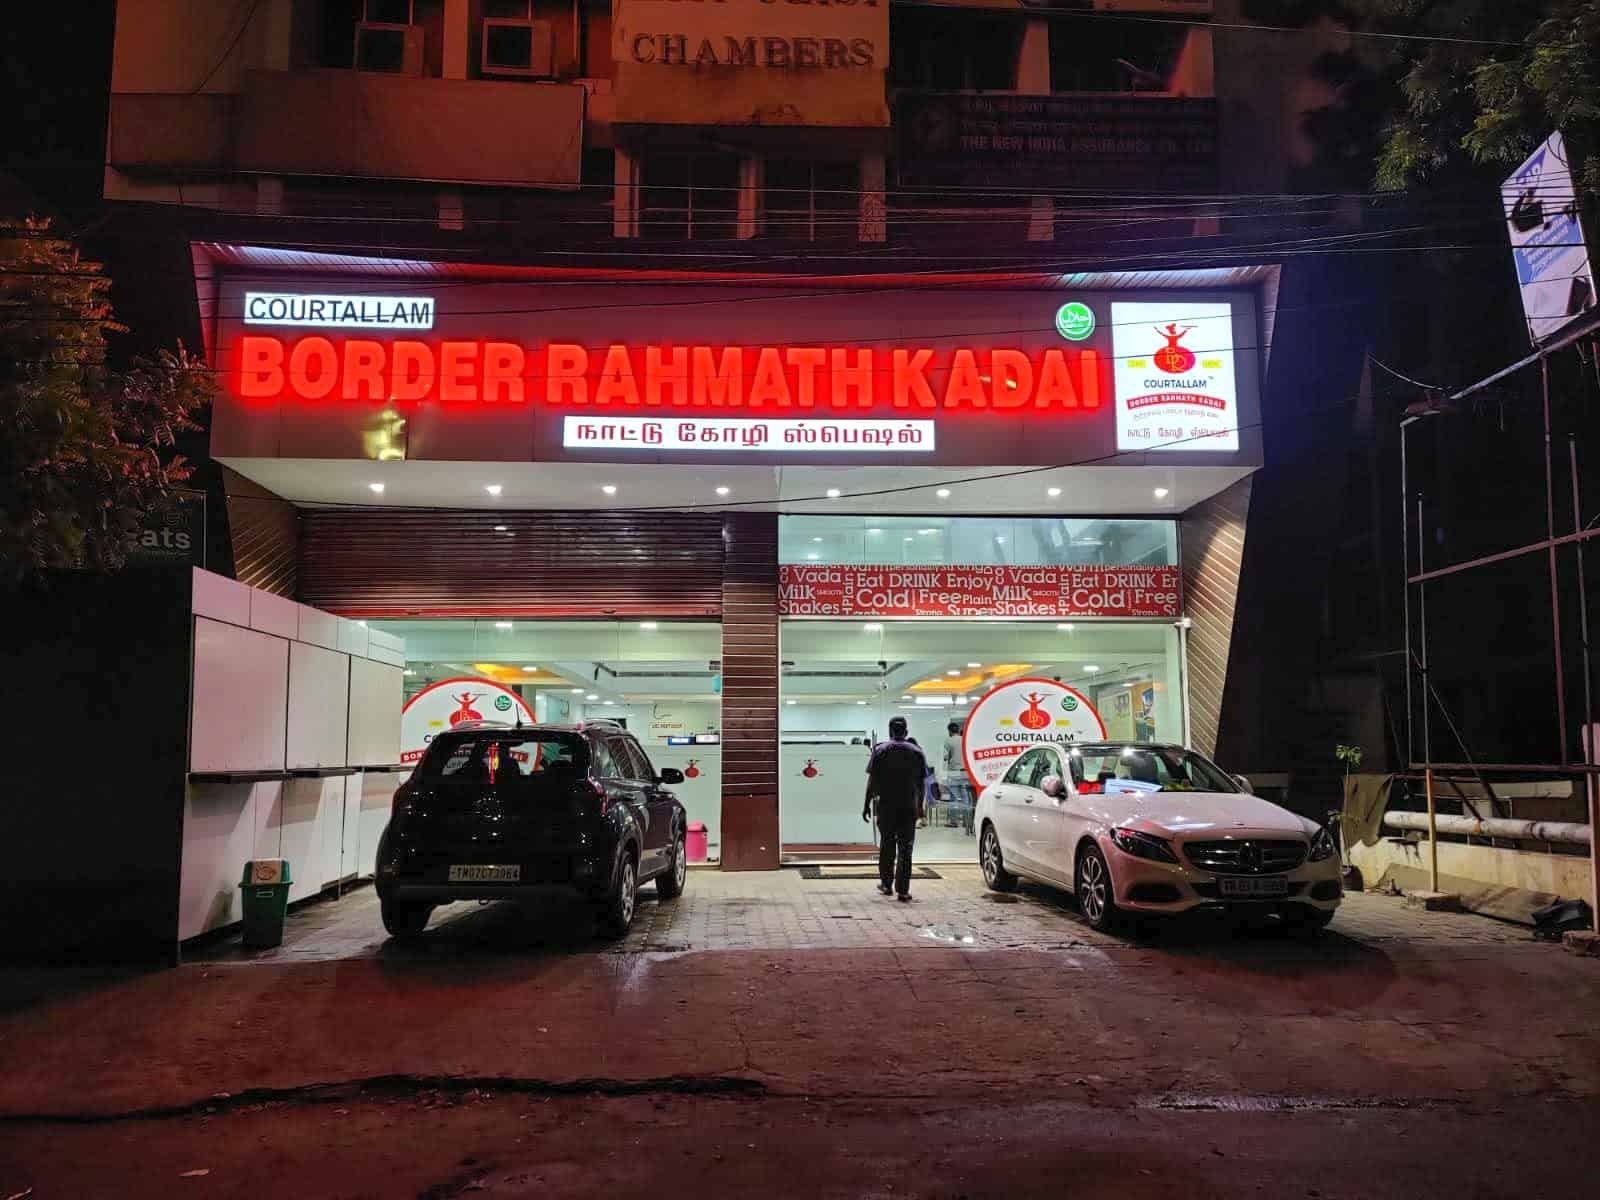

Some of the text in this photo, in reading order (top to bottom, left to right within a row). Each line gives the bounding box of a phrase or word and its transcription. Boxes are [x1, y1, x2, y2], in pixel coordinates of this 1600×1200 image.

[631, 33, 875, 68] CHAMBERS
[249, 297, 431, 324] COURTALLAM
[239, 336, 1099, 409] BORDER RAHMATH KADAI
[1143, 379, 1207, 389] COURTALLAM
[577, 422, 922, 447] நாட்டு கோழி ஸ்பெஷல்
[793, 569, 841, 583] Vada
[857, 573, 883, 588] Eat
[889, 573, 942, 588] DRINK
[947, 573, 993, 591] Enjoy
[1008, 570, 1056, 584] Vada
[1072, 573, 1099, 588] Eat
[1105, 573, 1157, 588] DRINK
[778, 584, 816, 600] Milk
[856, 588, 909, 608] Cold
[919, 589, 961, 604] Free
[963, 594, 992, 605] Plain
[992, 585, 1032, 601] Milk
[1072, 589, 1125, 609] Cold
[1135, 589, 1177, 604] Free
[779, 600, 840, 614] Shakes
[995, 601, 1056, 616] Shakes
[995, 732, 1074, 742] COURTALLAM
[403, 751, 424, 762] BOR
